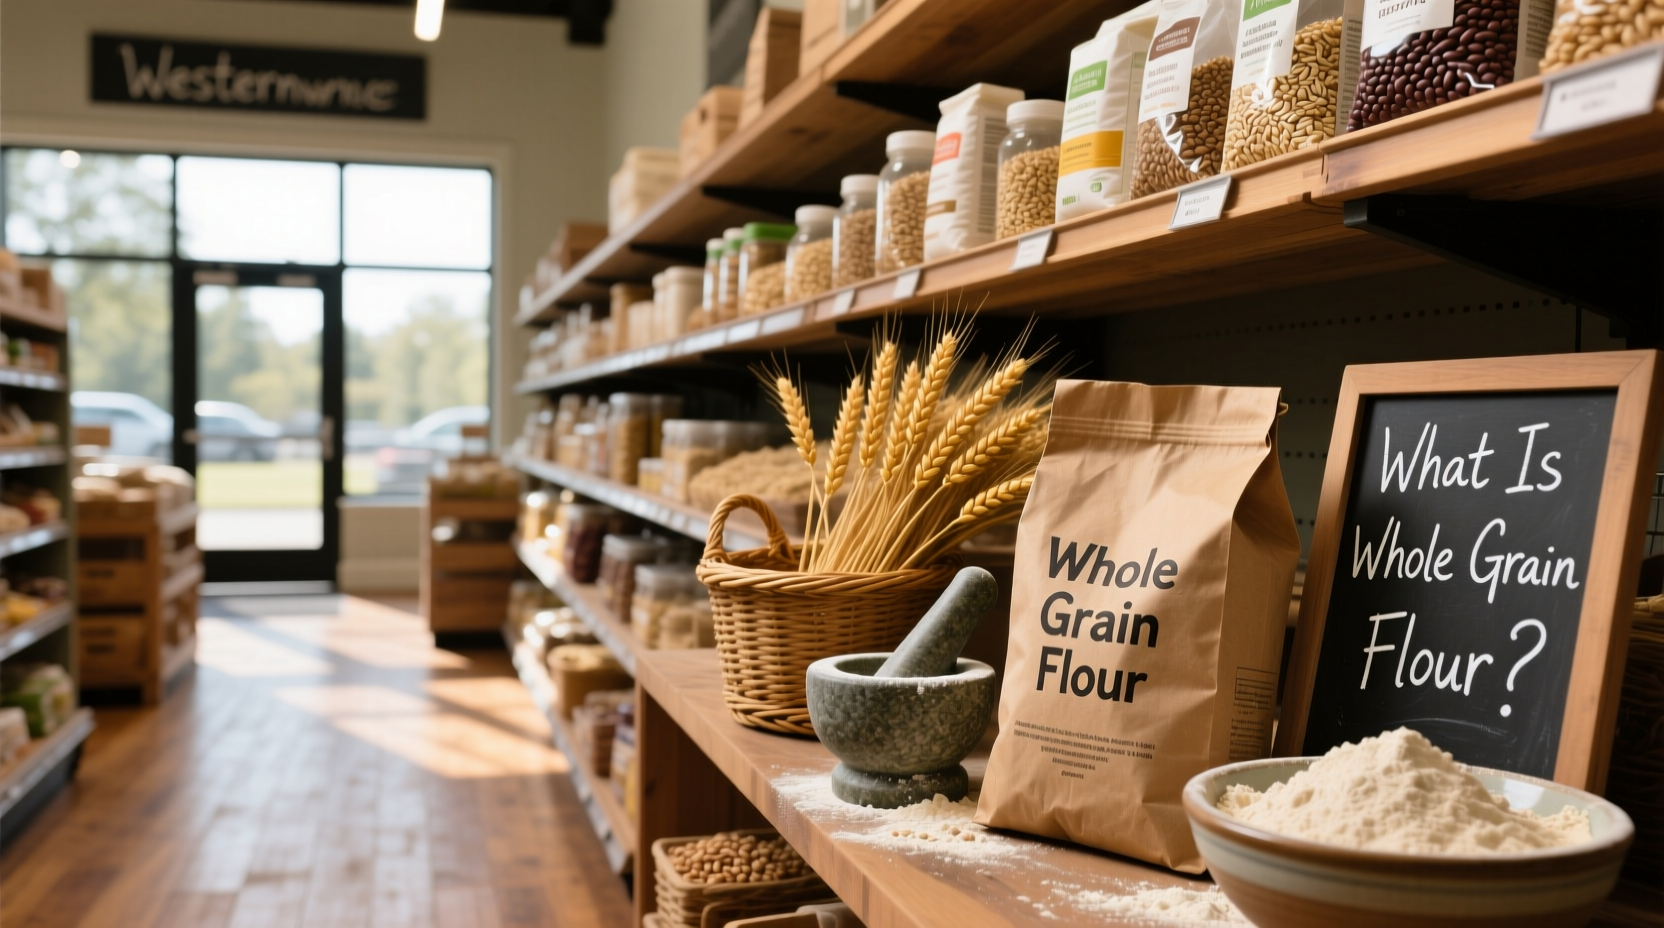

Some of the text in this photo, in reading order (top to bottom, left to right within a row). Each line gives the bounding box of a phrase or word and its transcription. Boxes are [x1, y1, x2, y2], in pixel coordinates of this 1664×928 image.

[1380, 421, 1564, 495] What Is
[1047, 536, 1179, 590] Whole
[1351, 516, 1581, 604] Whole Grain
[1040, 591, 1160, 648] Grain
[1036, 646, 1149, 704] Flour
